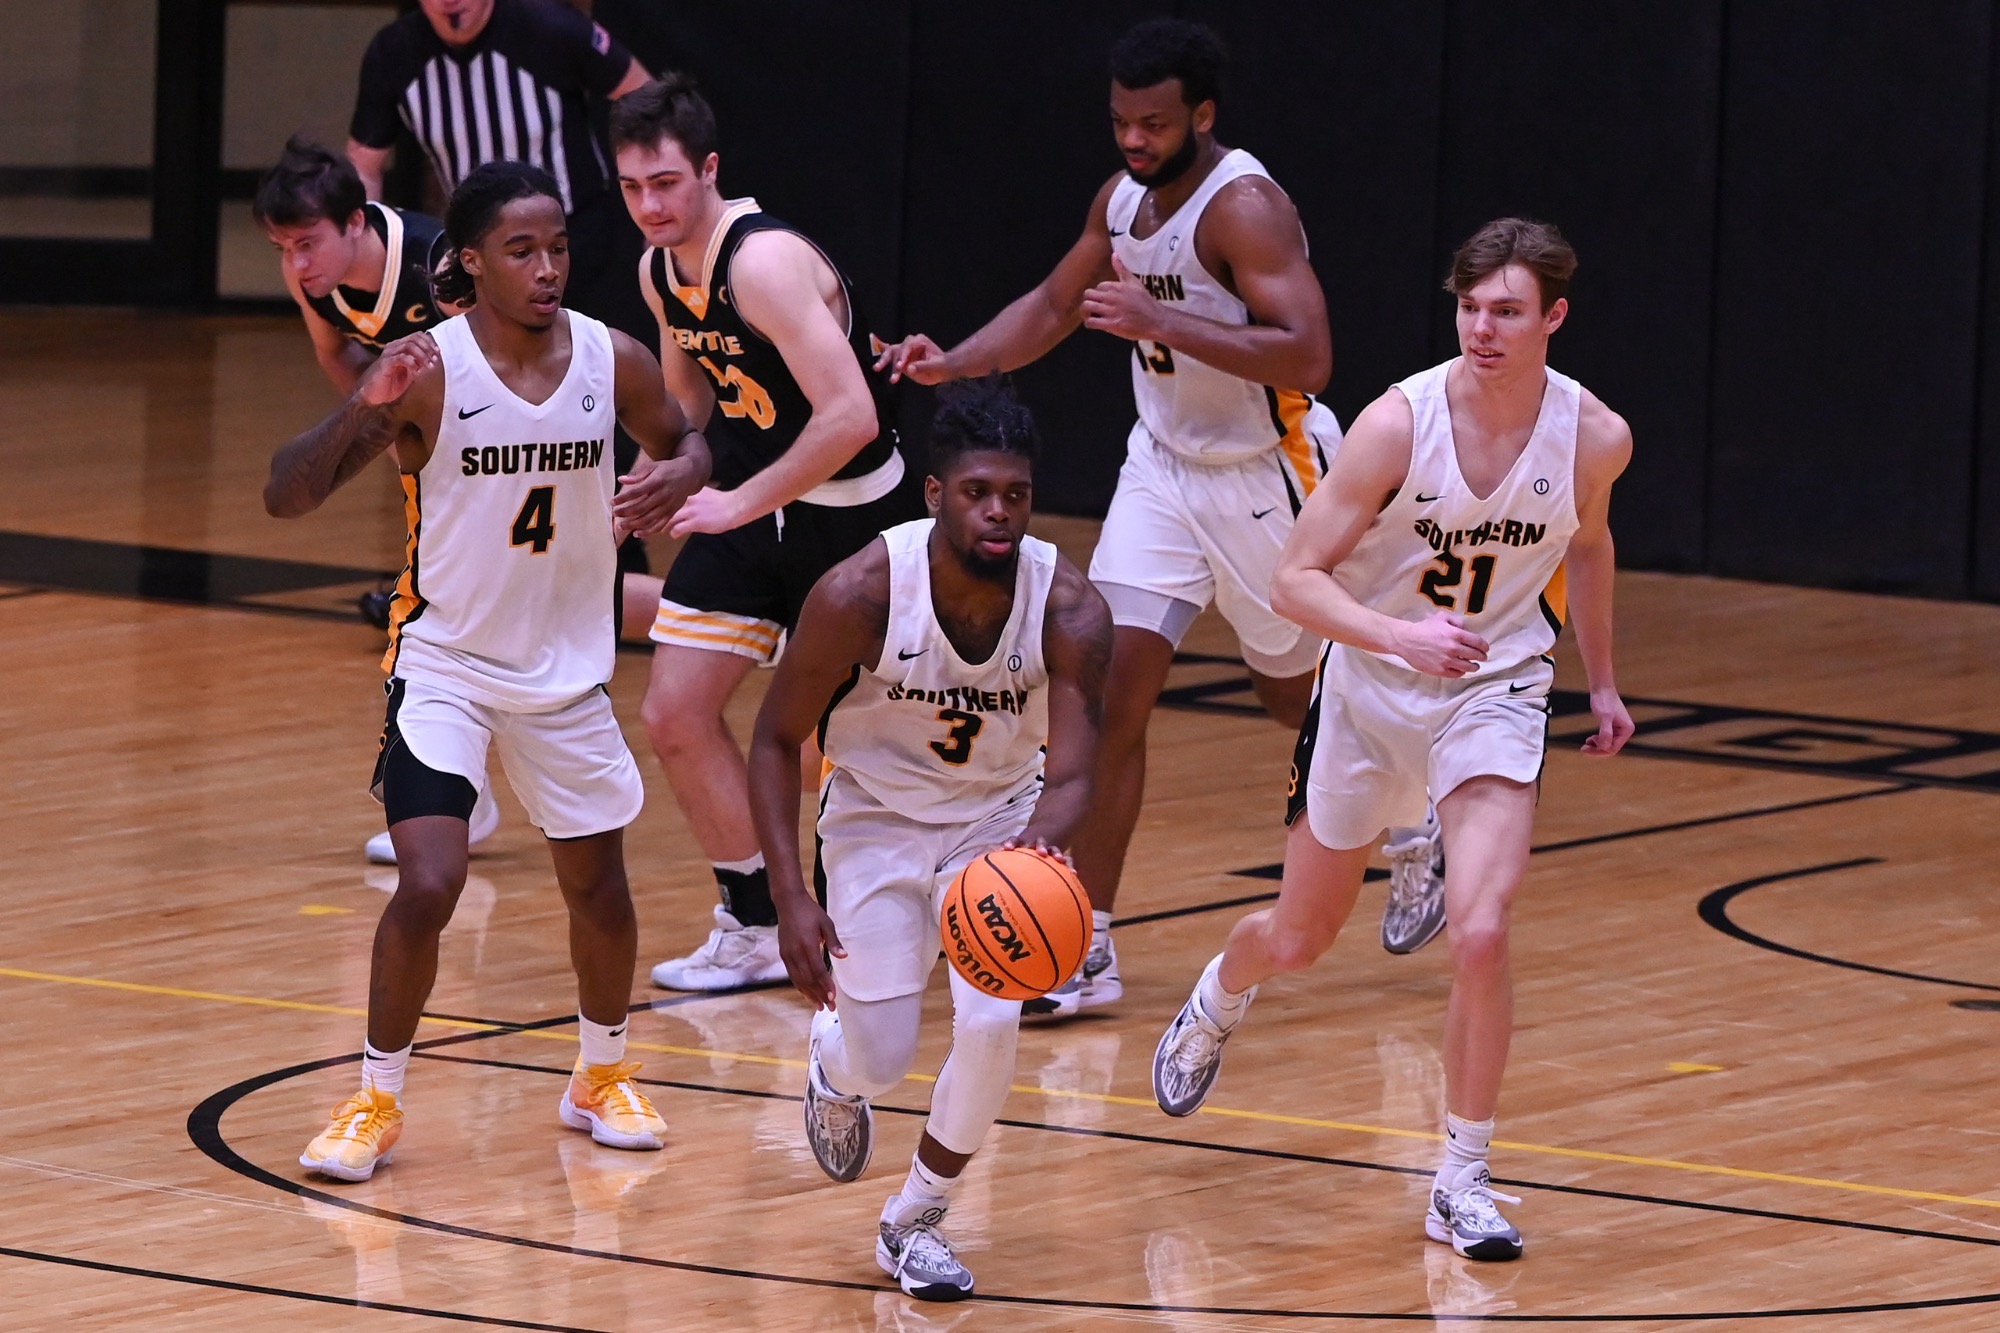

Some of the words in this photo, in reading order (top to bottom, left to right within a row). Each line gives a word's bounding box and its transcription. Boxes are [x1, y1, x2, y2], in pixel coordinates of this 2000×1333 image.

[405, 303, 428, 323] C
[461, 438, 605, 477] SOUTHERN
[509, 484, 557, 556] 4
[1413, 517, 1547, 552] SOUTHERN
[1416, 551, 1499, 617] 21
[886, 682, 1029, 717] SOUTHERN
[927, 707, 986, 768] 3
[977, 893, 1031, 963] NCAA
